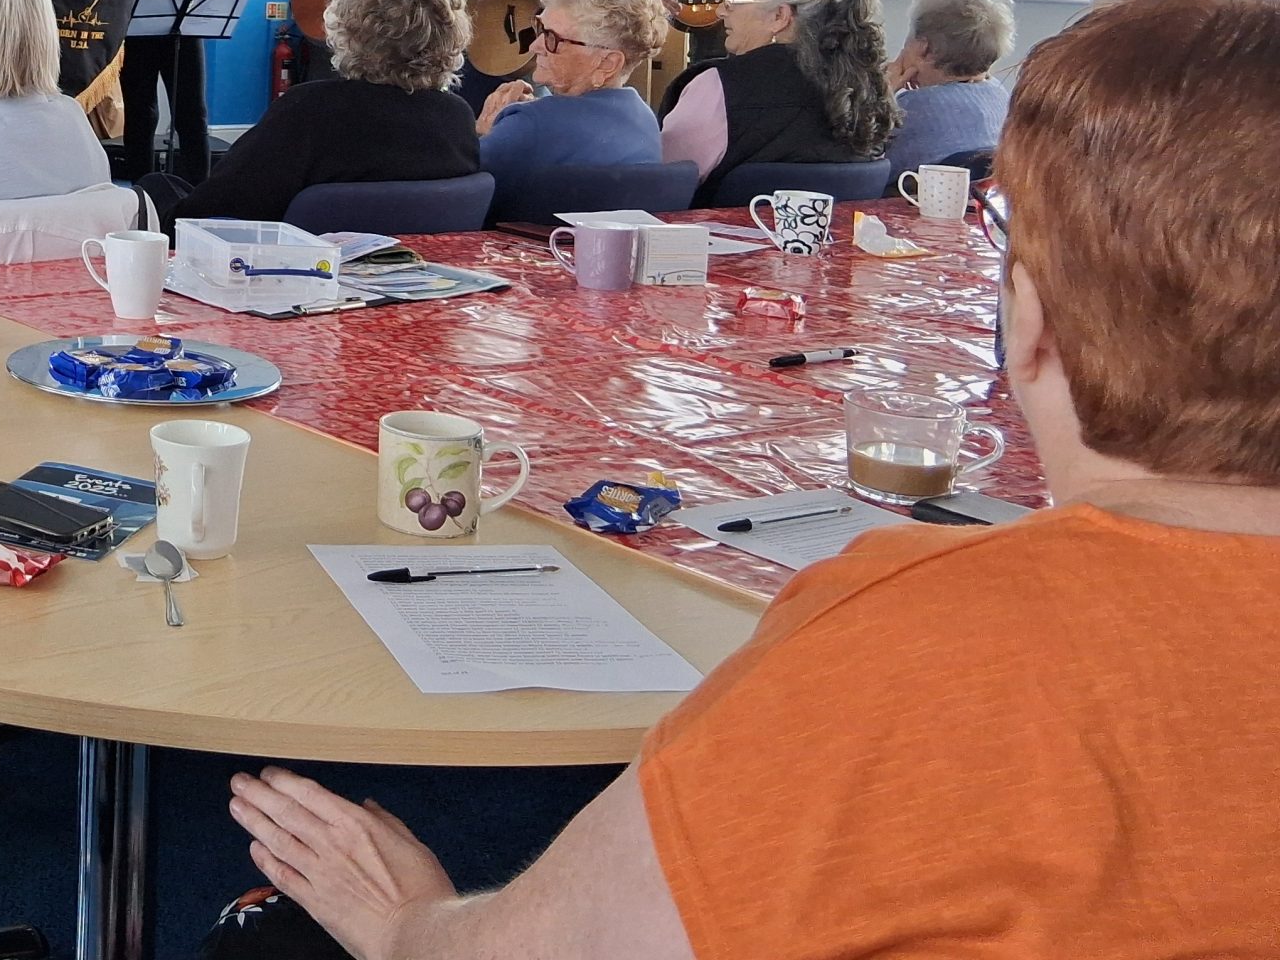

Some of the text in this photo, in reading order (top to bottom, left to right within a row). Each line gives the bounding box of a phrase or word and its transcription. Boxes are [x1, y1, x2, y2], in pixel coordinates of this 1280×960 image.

[91, 31, 105, 40] THE
[74, 474, 132, 489] Events
[600, 486, 645, 503] SHORTIES
